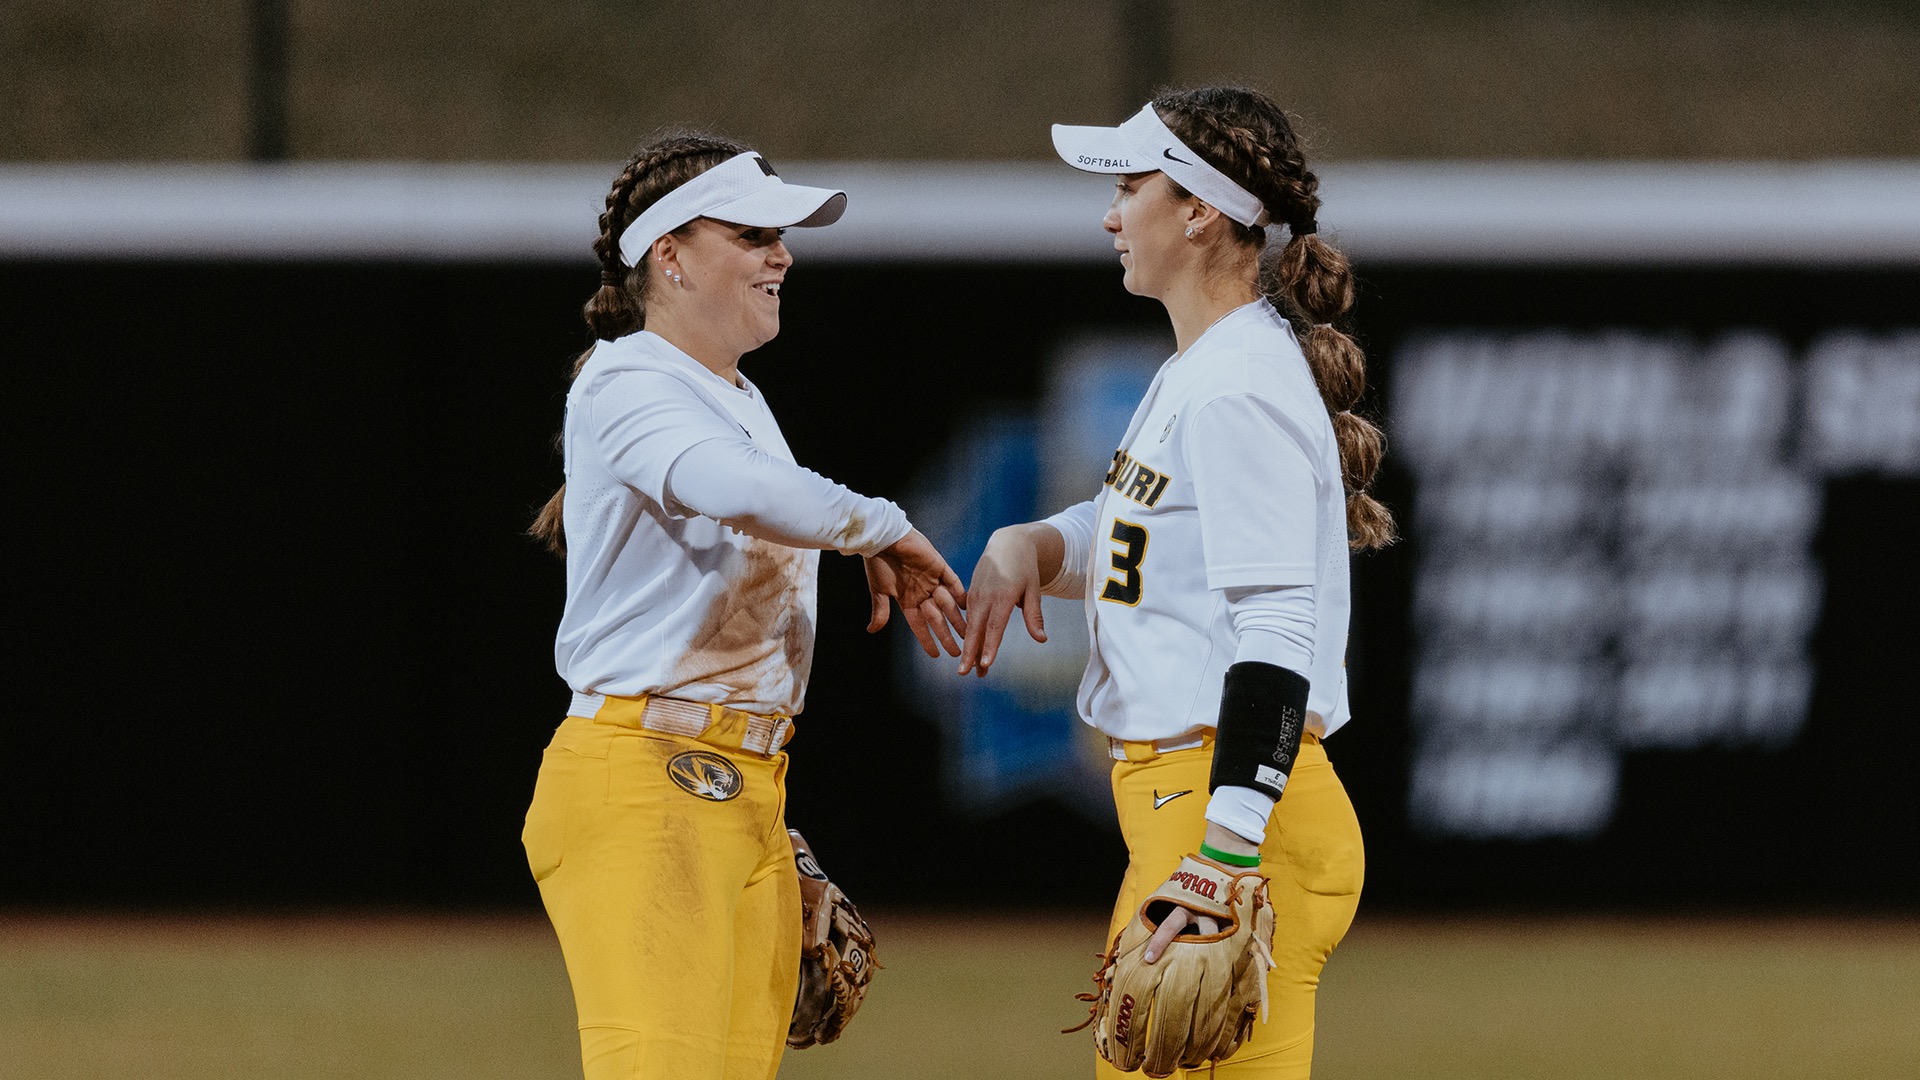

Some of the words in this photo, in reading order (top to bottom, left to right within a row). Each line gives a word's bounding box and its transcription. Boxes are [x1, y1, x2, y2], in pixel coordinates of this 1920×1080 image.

[1077, 154, 1131, 168] SOFTBALL
[1098, 517, 1150, 607] 3
[1115, 993, 1136, 1049] A2000
